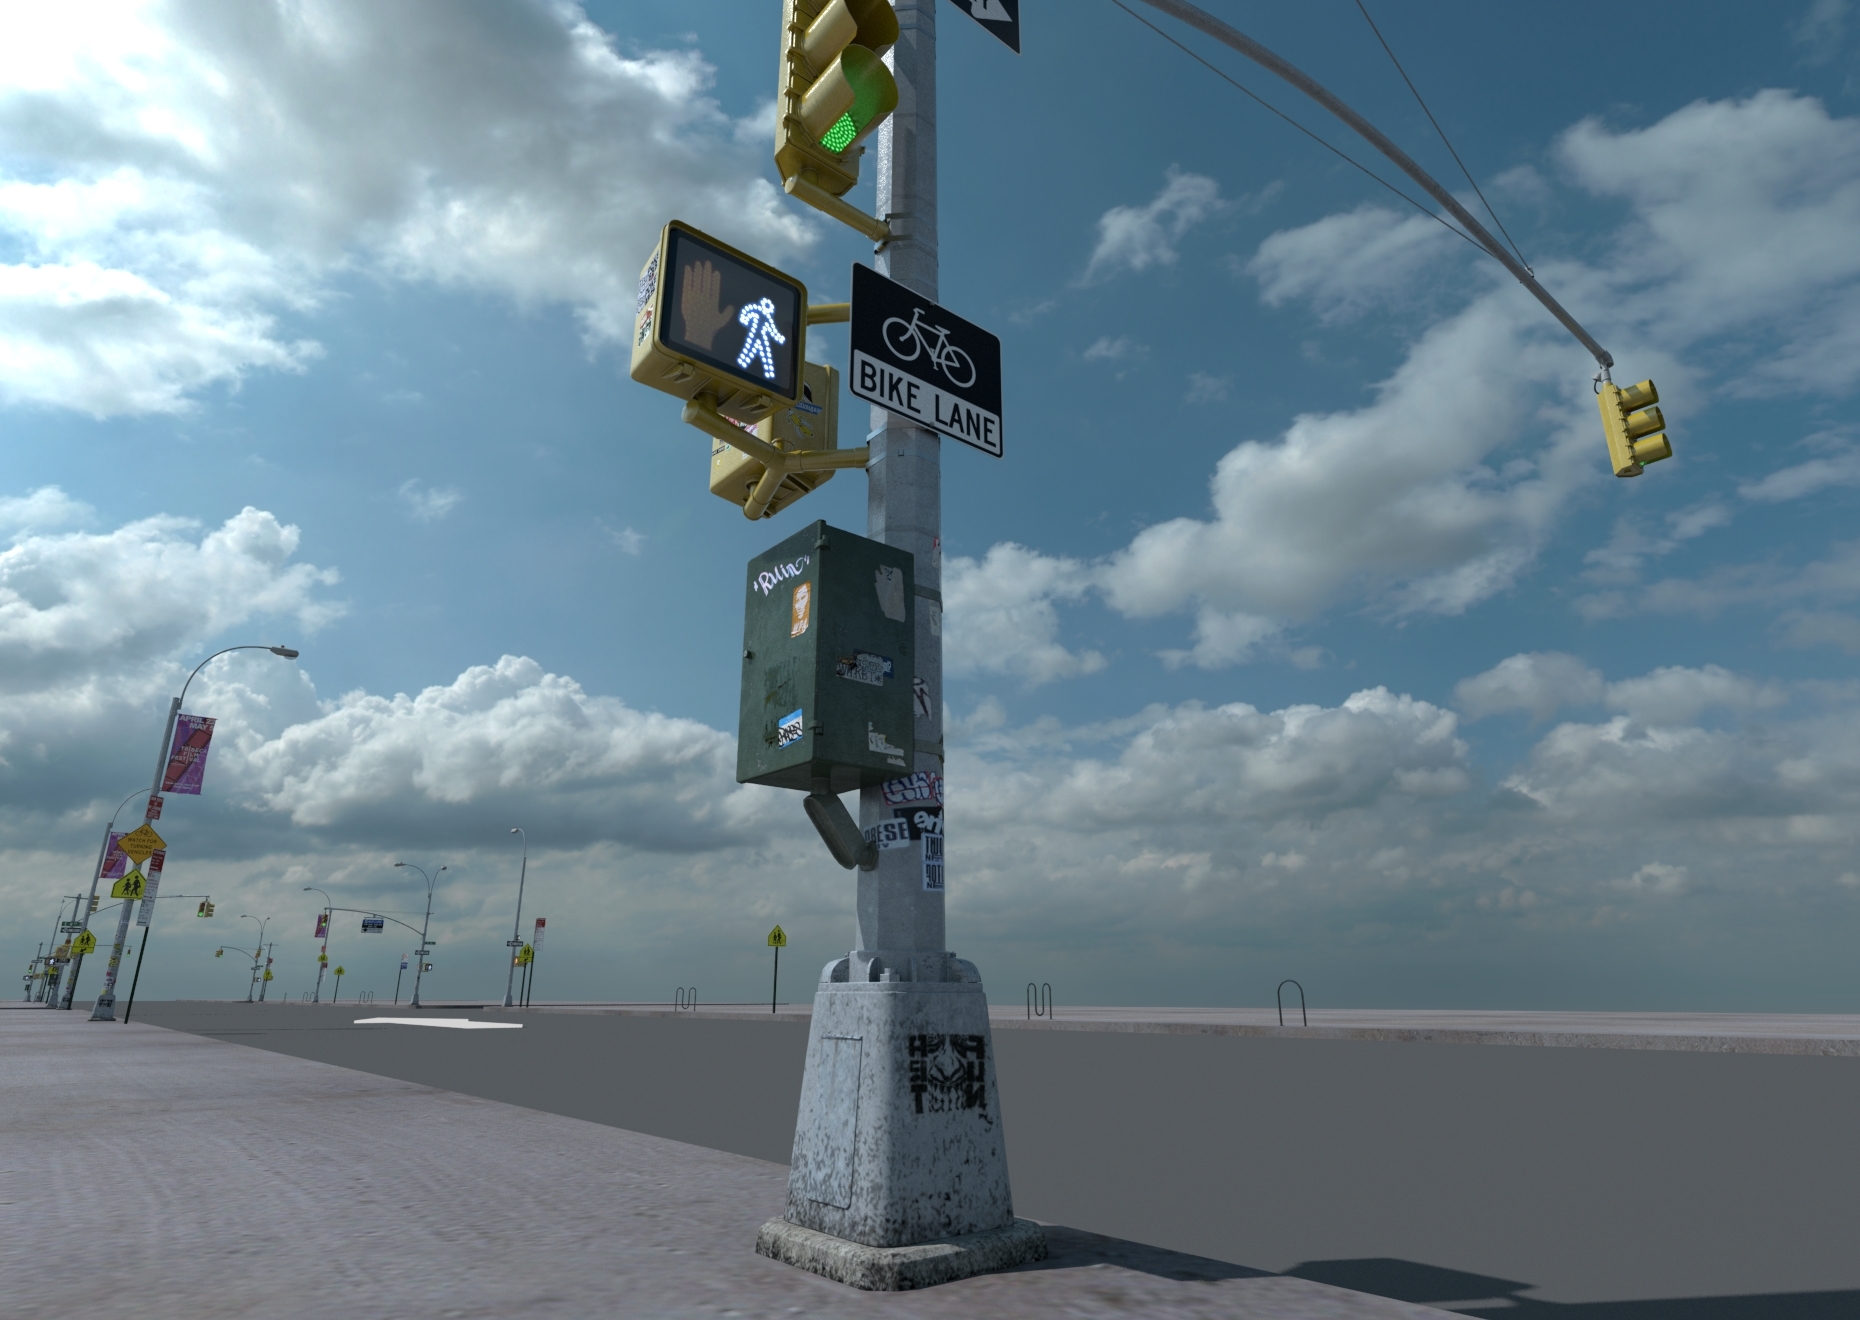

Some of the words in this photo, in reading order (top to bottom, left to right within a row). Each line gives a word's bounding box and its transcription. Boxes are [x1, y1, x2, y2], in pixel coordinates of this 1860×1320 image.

[860, 359, 921, 414] BIKE
[935, 394, 997, 448] LANE
[179, 714, 204, 725] APRIL
